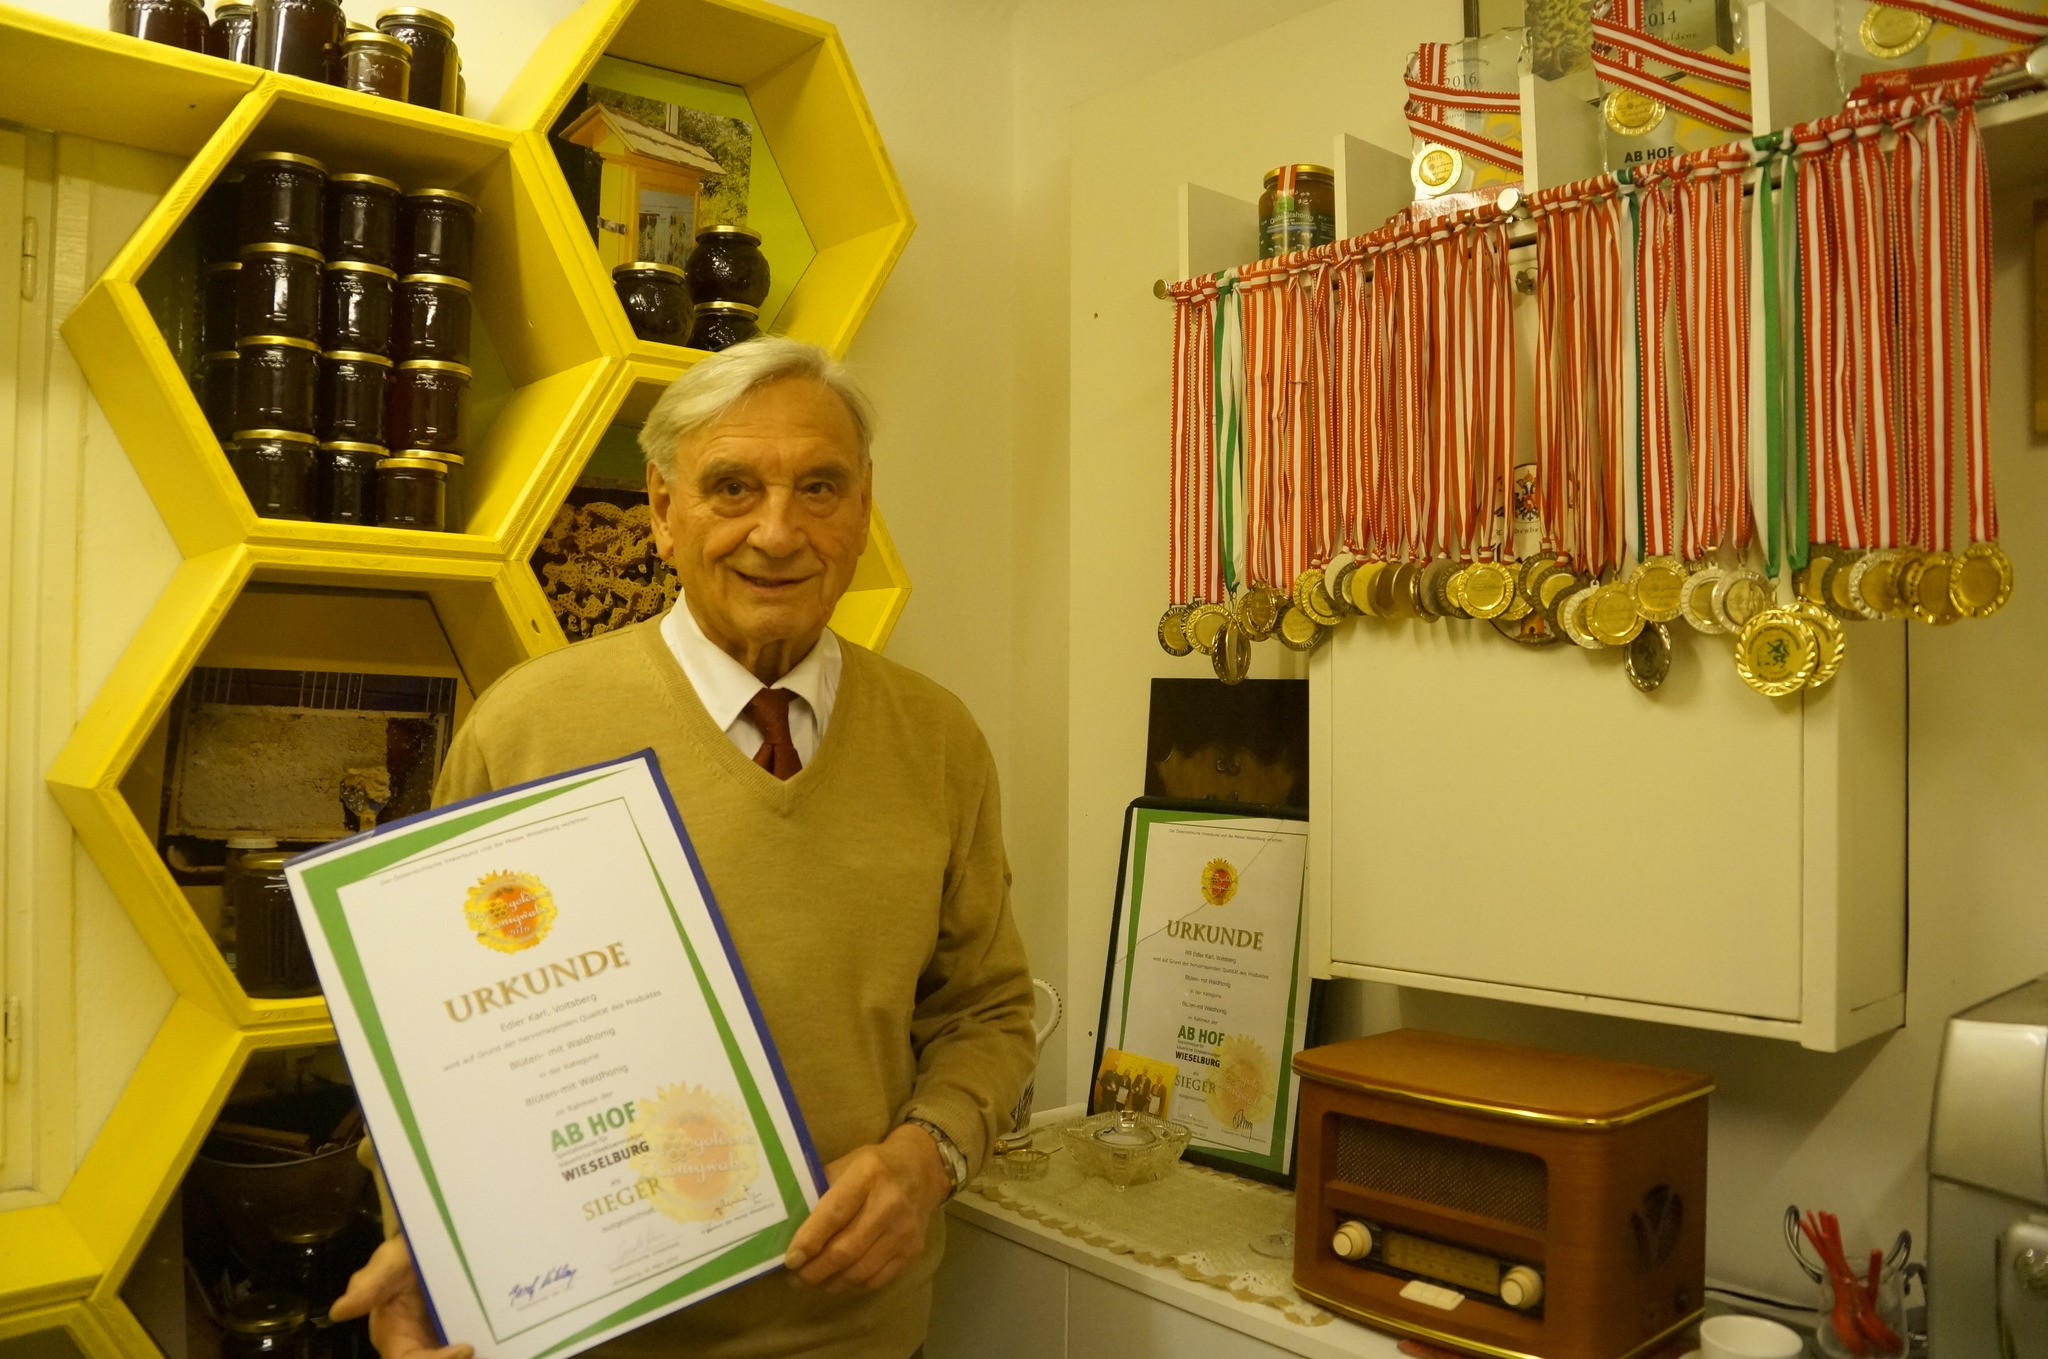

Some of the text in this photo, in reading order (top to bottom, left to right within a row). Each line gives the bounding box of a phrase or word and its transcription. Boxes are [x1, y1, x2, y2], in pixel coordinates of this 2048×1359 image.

[1643, 10, 1676, 28] 014
[1624, 146, 1674, 164] AB HOF
[1166, 919, 1264, 952] URKUNDE
[443, 941, 631, 1024] URKUNDE
[500, 1018, 525, 1032] Edler
[552, 992, 597, 1014] Voitsberg
[548, 1044, 565, 1057] mit
[566, 1027, 616, 1050] Waldhonig
[1177, 1025, 1225, 1047] AB HOF
[1175, 1050, 1221, 1068] WIESELBURG
[578, 1063, 629, 1087] Waldhonig
[1174, 1074, 1216, 1095] SIEGER
[551, 1101, 636, 1153] AB HOF
[561, 1141, 650, 1182] WIESELBURG
[582, 1177, 664, 1222] SIEGER
